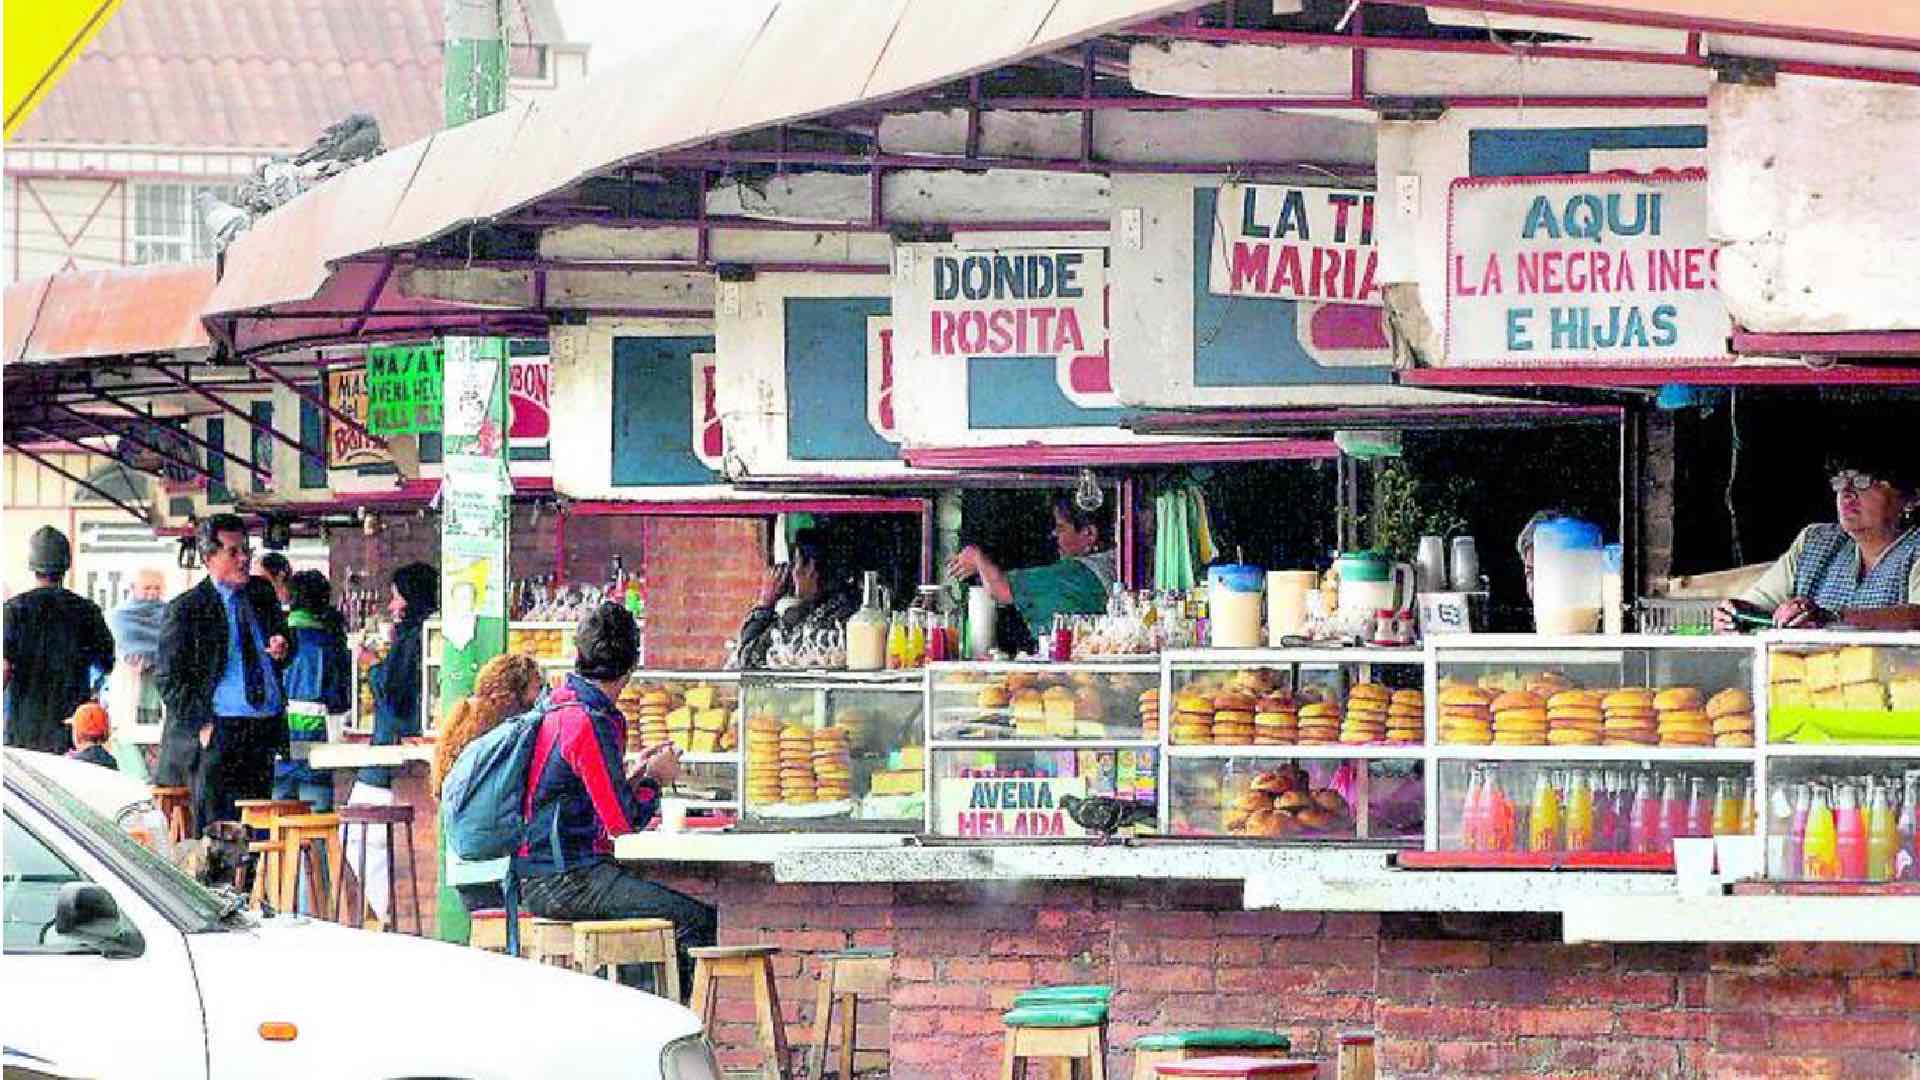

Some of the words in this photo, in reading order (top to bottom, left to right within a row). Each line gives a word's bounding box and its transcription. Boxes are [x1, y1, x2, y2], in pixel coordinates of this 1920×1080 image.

[1241, 187, 1310, 240] LA
[1328, 193, 1375, 245] TI
[1522, 194, 1662, 243] AQUI
[934, 253, 1084, 300] DONDE
[1230, 241, 1378, 300] MARIA
[1456, 253, 1502, 296] LA
[1518, 250, 1635, 294] NEGRA
[930, 307, 1085, 355] ROSITA
[1507, 307, 1533, 351] E
[1550, 304, 1678, 349] HIJAS
[969, 781, 1053, 809] AVENA
[958, 811, 1065, 837] HELADA
